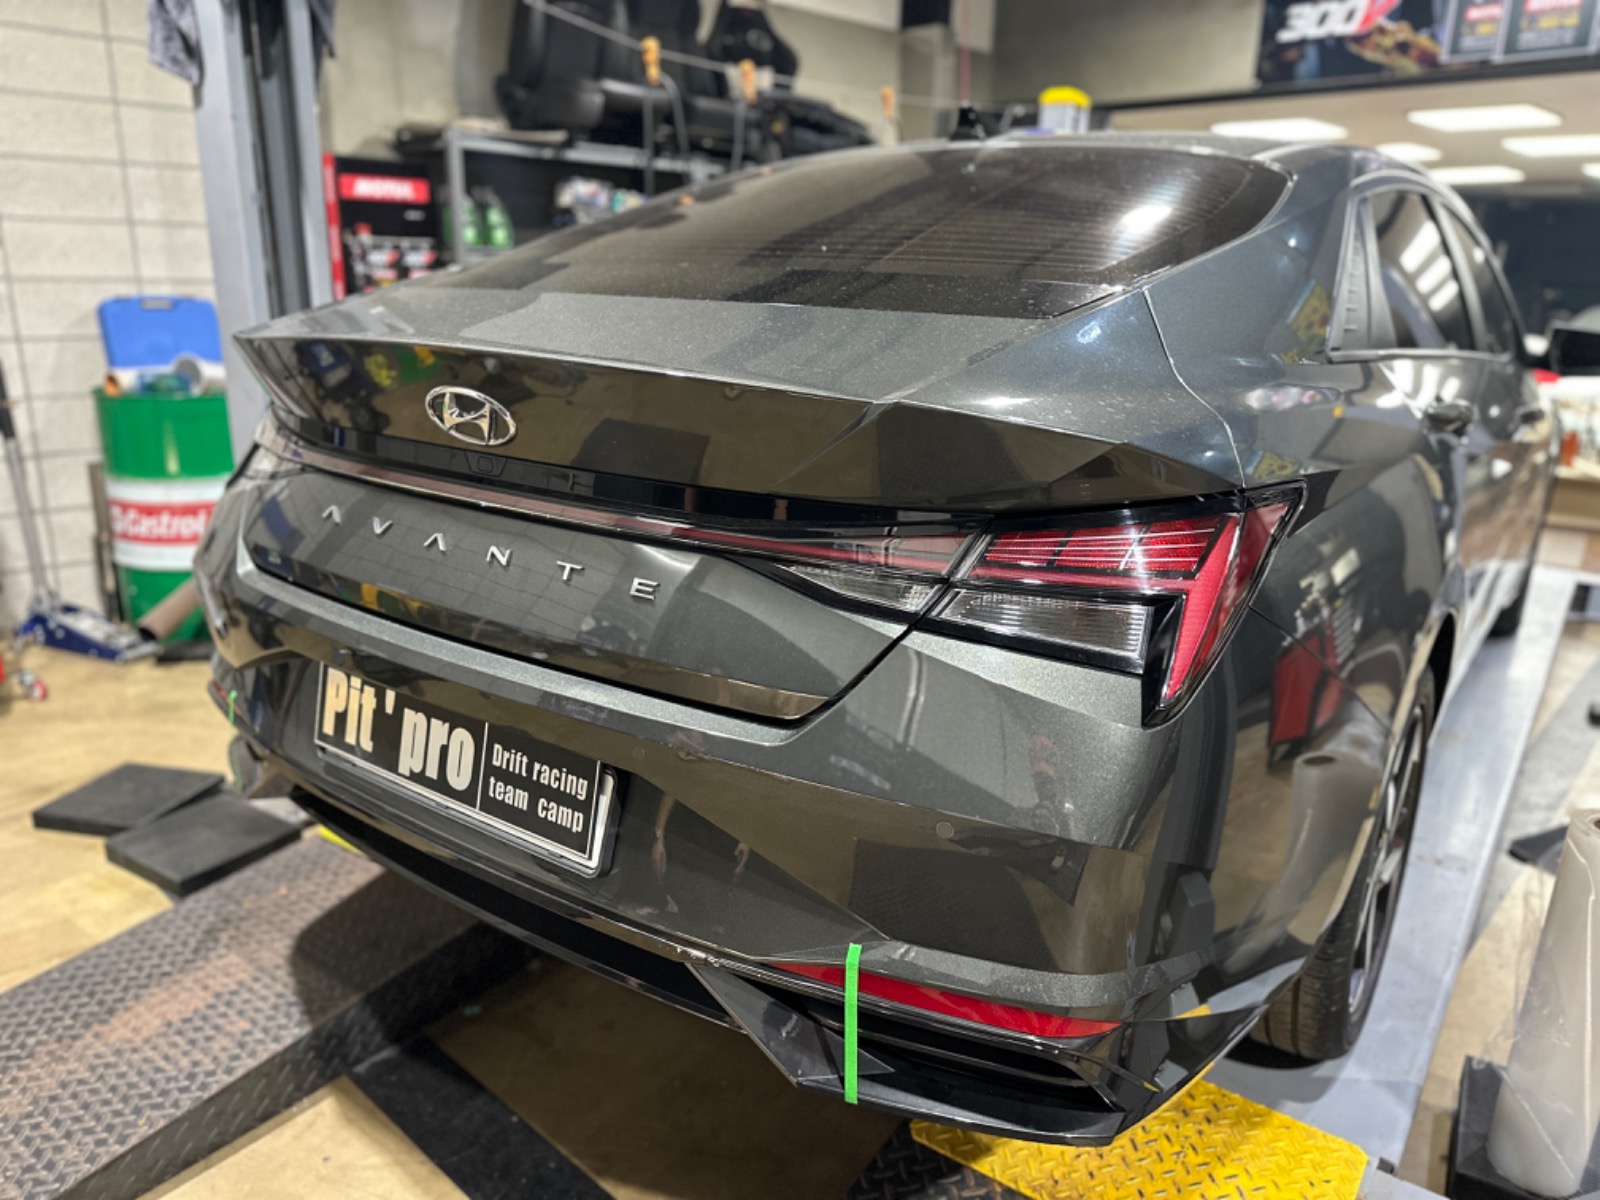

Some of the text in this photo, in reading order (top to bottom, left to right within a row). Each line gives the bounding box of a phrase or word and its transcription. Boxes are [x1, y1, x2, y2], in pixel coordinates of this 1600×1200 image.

[322, 505, 660, 600] AVANTE
[492, 743, 588, 801] Drift racing
[488, 775, 583, 834] team camp
